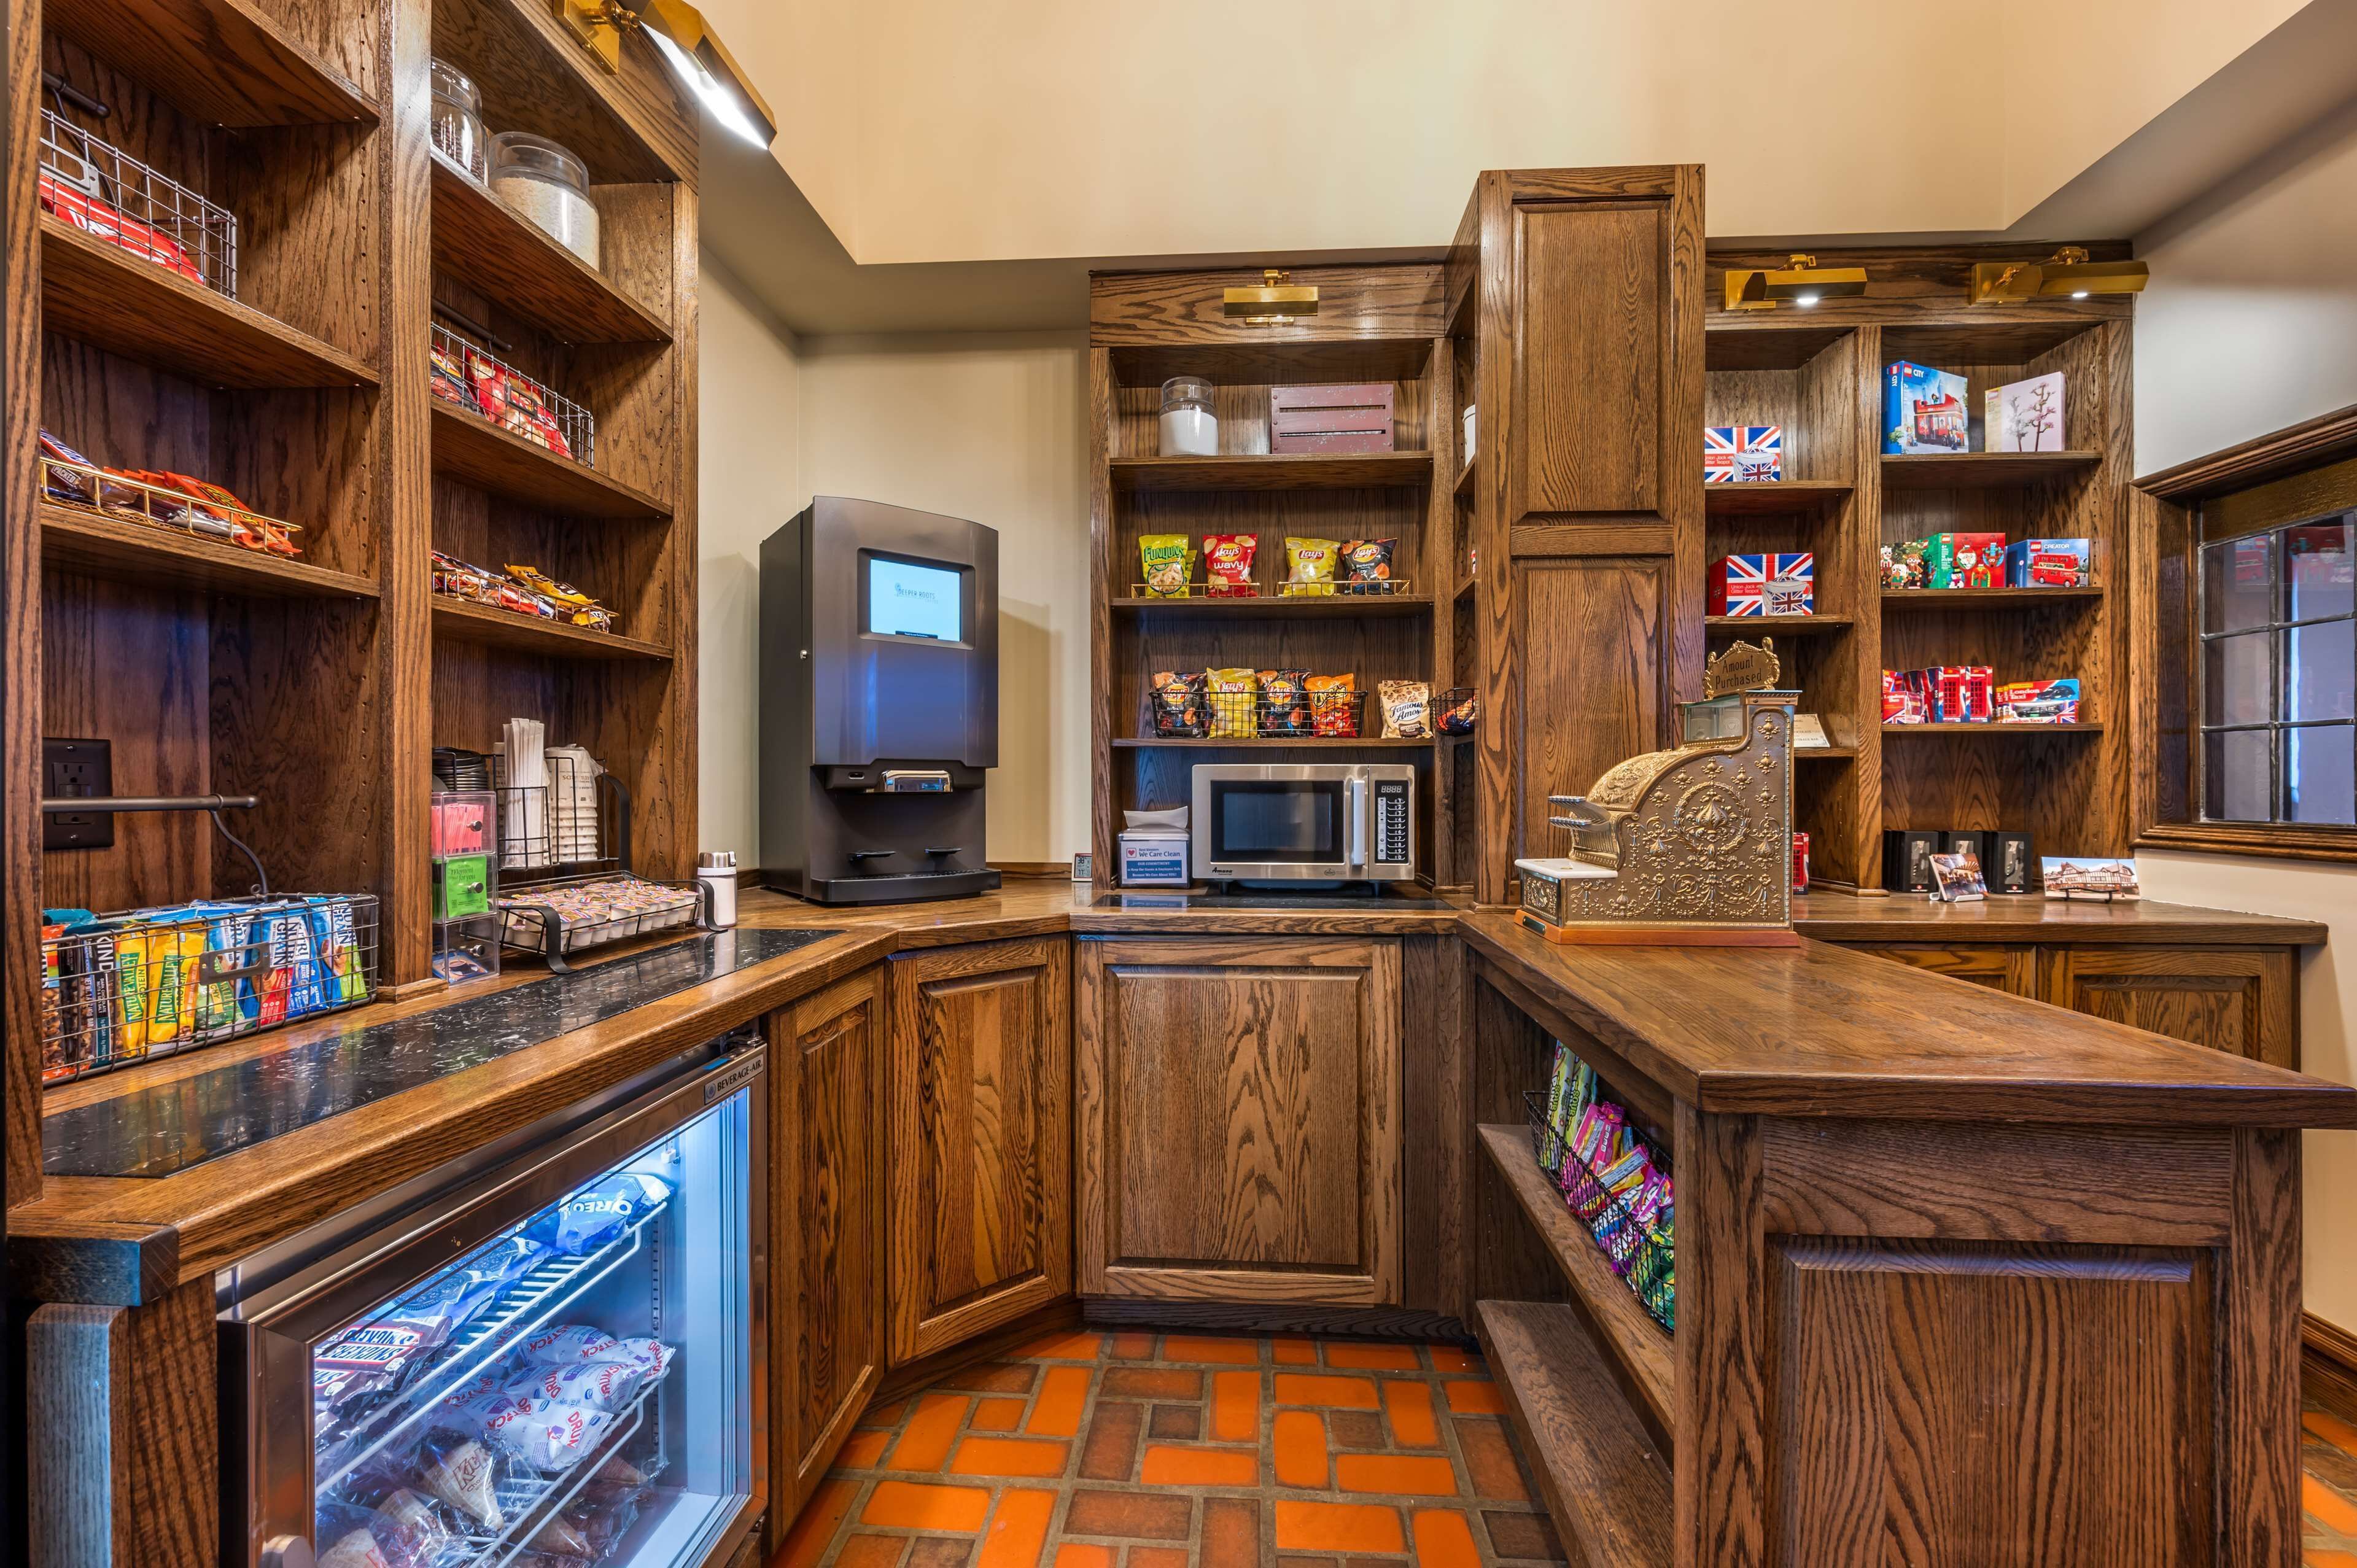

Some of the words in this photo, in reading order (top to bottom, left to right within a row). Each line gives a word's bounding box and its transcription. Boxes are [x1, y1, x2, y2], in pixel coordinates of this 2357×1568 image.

[1913, 369, 1924, 378] CITY
[53, 465, 77, 484] PACKED
[1219, 546, 1240, 557] Lay's
[1299, 549, 1324, 559] Lay's
[1354, 546, 1379, 559] Lay's
[1214, 561, 1244, 570] wavy
[1722, 654, 1754, 674] Amount
[1715, 668, 1762, 690] Purchased
[1389, 701, 1423, 718] Famous
[1393, 710, 1421, 723] Amos
[333, 906, 350, 944] GRAIN
[96, 936, 114, 972] KIND
[273, 922, 287, 966] GRAIN
[287, 922, 300, 966] NUTRI
[122, 955, 138, 985] VALLEY
[138, 969, 147, 1004] PROTEIN
[123, 986, 144, 1021] NATURE
[157, 987, 176, 1021] NATURE
[1551, 1084, 1561, 1112] SOUR
[1569, 1089, 1580, 1117] SOUR
[572, 1199, 634, 1216] OREO
